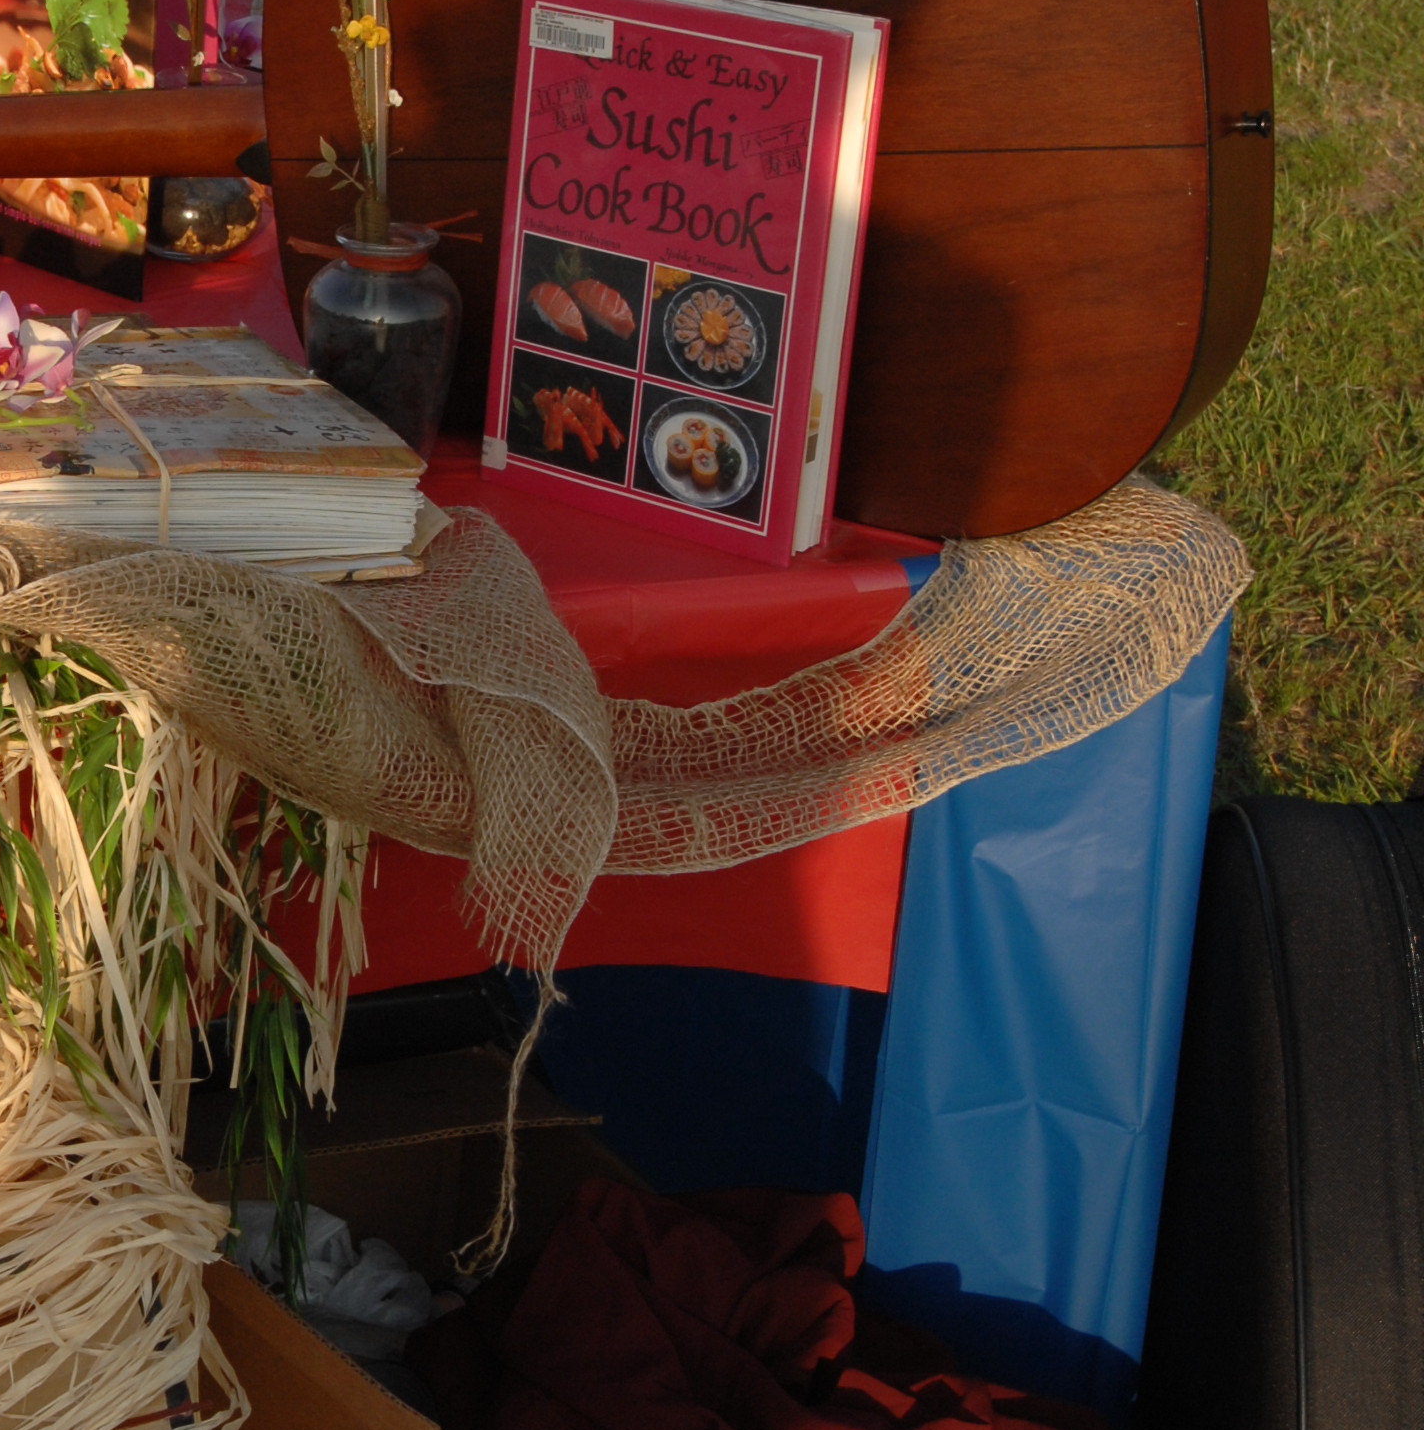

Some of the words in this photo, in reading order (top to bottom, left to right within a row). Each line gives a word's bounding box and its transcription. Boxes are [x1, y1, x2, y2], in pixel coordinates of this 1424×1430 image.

[576, 37, 654, 70] ick
[666, 50, 697, 79] &
[706, 53, 789, 110] Easy
[586, 86, 738, 171] Sushi
[525, 152, 637, 225] Cook
[643, 180, 790, 275] Book
